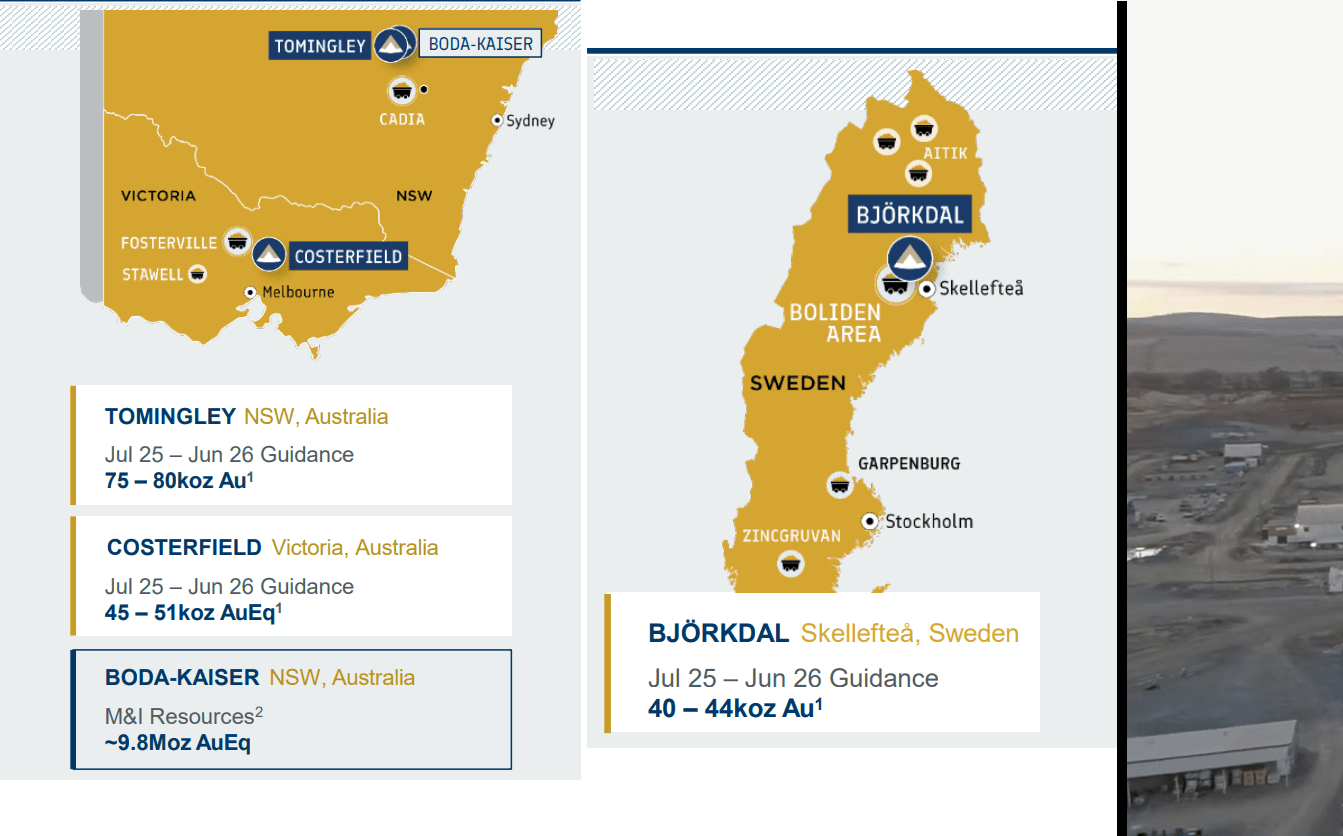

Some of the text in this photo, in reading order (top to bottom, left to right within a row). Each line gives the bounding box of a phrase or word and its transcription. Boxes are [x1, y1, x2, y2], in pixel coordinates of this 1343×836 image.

[275, 39, 365, 53] TOMINGLEY
[430, 37, 533, 50] BODA-KAISER
[380, 113, 425, 125] CADIA
[507, 114, 555, 129] Sydney
[924, 147, 968, 159] AITIK
[121, 190, 196, 201] VICTORIA
[397, 190, 432, 201] NSW
[858, 202, 964, 224] BJÖRKDAL
[122, 237, 217, 249] FOSTERVILLE
[295, 249, 402, 264] COSTERFIELD
[123, 268, 183, 281] STAWELL
[263, 285, 335, 298] Melbourne
[940, 280, 1023, 296] Skellefteå
[791, 303, 880, 320] BOLIDEN
[827, 326, 881, 342] AREA
[751, 375, 845, 391] SWEDEN
[105, 408, 388, 427] TOMINGLEY NSW, Australia
[105, 446, 132, 463] Jul
[139, 446, 163, 463] 25
[188, 446, 222, 463] Jun
[230, 446, 253, 462] 26
[261, 446, 354, 463] Guidance
[859, 457, 960, 470] GARPENBURG
[105, 472, 129, 489] 75
[153, 472, 214, 489] 80koz
[886, 514, 973, 529] Stockholm
[743, 529, 840, 542] ZINCGRUVAN
[107, 539, 438, 558] COSTERFIELD Victoria, Australia
[105, 578, 132, 595] Jul
[139, 578, 163, 595] 25
[188, 578, 222, 595] Jun
[230, 578, 253, 594] 26
[261, 578, 354, 595] Guidance
[105, 604, 129, 621] 45
[154, 604, 215, 621] 51koz
[649, 619, 1018, 645] BJÖRKDAL Skellefteå, Sweden
[106, 669, 414, 688] BODA-KAISER NSW, Australia
[648, 668, 679, 687] Jul
[688, 668, 716, 687] 25
[745, 668, 785, 687] Jun
[794, 668, 821, 687] 26
[830, 668, 938, 687] Guidance
[106, 708, 142, 724] M&I
[648, 698, 676, 718] 40
[705, 698, 776, 718] 44koz
[105, 734, 250, 755] ~9.8Moz AuEq
